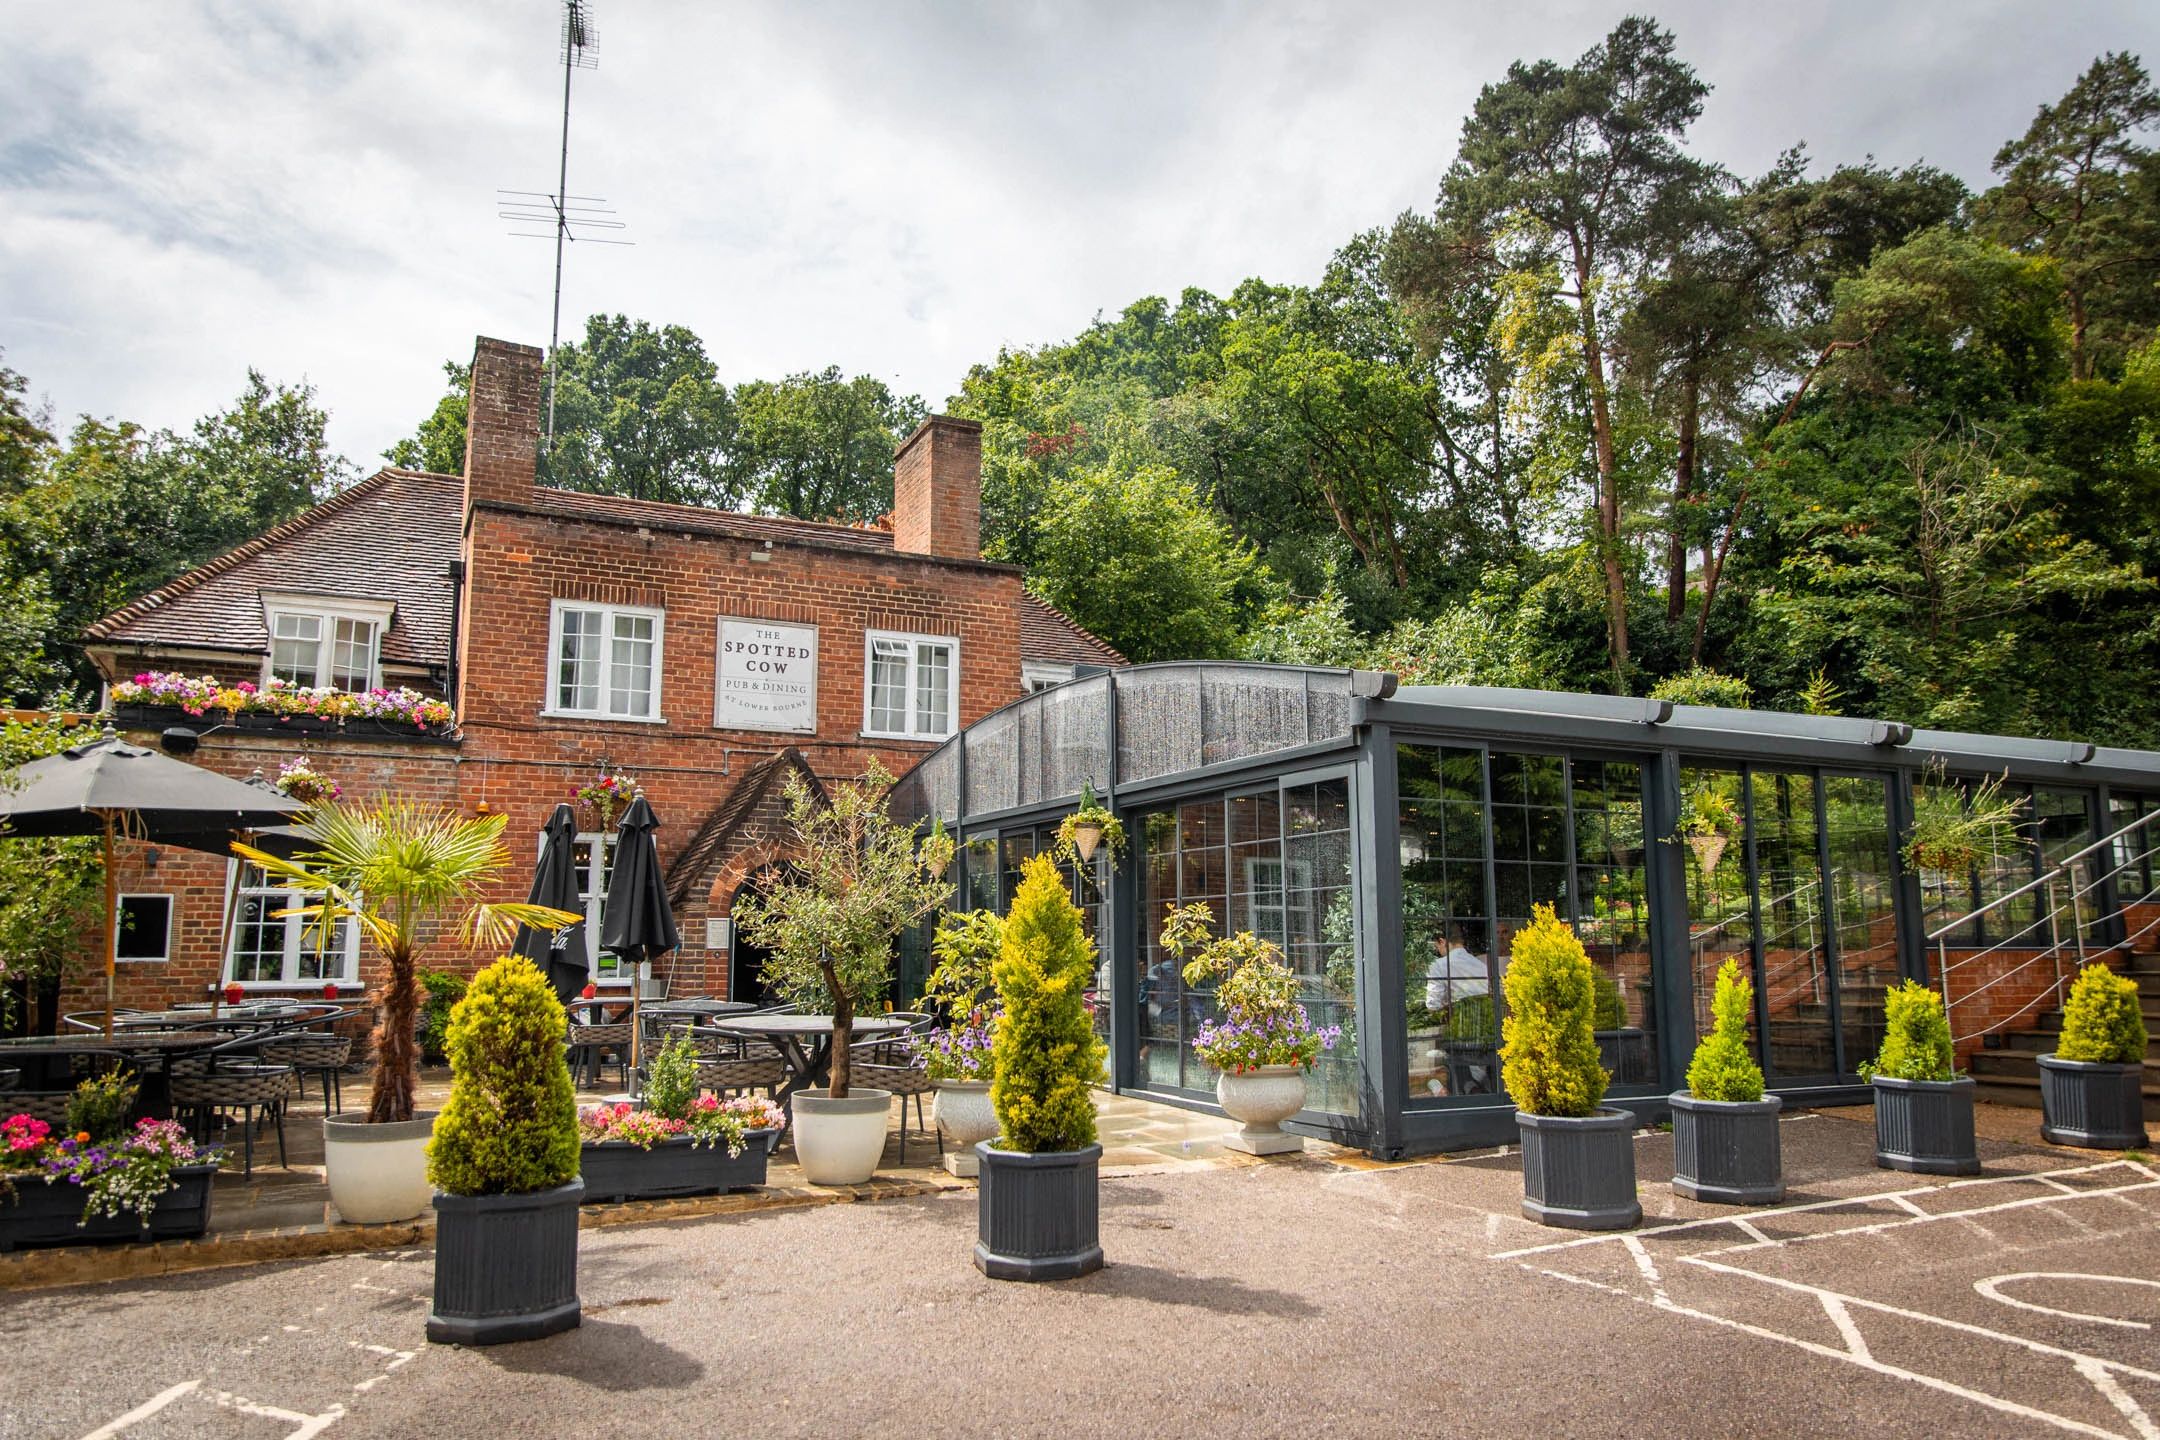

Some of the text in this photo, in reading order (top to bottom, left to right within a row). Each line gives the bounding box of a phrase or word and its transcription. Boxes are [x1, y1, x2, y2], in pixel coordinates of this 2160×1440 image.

[756, 630, 780, 640] THE
[725, 641, 810, 659] SPOTTED
[746, 660, 788, 674] COW
[726, 680, 807, 694] PUB & DINING
[739, 699, 769, 711] LOWER
[773, 699, 807, 712] BOURNE
